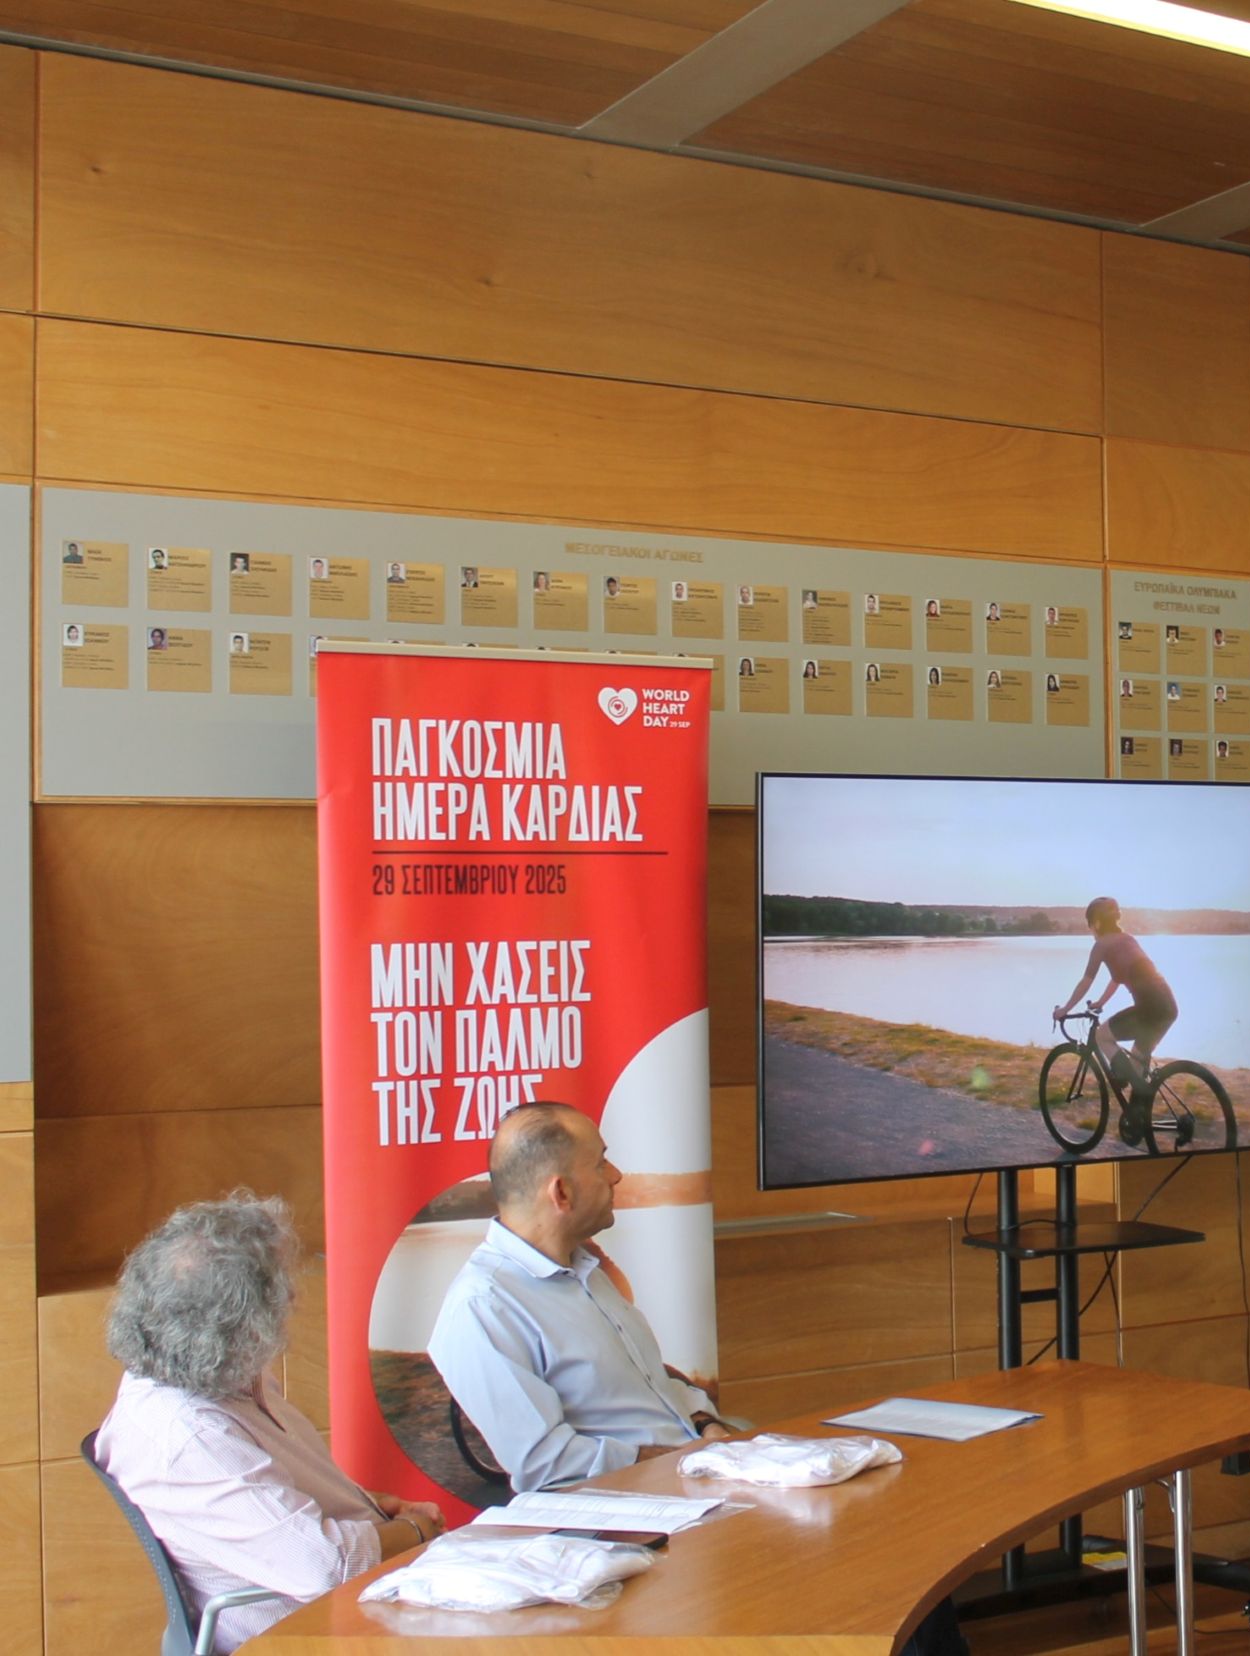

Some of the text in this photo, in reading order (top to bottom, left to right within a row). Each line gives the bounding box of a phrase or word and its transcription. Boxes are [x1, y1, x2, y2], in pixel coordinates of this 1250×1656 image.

[565, 543, 704, 563] ΜΕΣΟΓΕΙΑΚΟΙ ΑΓΩΝΕΣ
[642, 689, 690, 702] WORLD
[643, 703, 685, 715] HEART
[643, 716, 669, 727] DAY
[371, 717, 567, 780] ΠΑΓΚΟΣΜΙΑ
[372, 782, 643, 842] ΗΜΕΡΑ ΚΑΡΔΙΑΣ
[372, 864, 566, 896] 29 ΣΕΠΤΕΜΒΡΙΟΥ 2025
[370, 940, 592, 1008] ΜΗΝ ΧΑΣΕΙΣ
[370, 1005, 582, 1077] ΤΟΝ ΠΑΛΜΟ
[372, 1079, 441, 1146] ΤΗΣ
